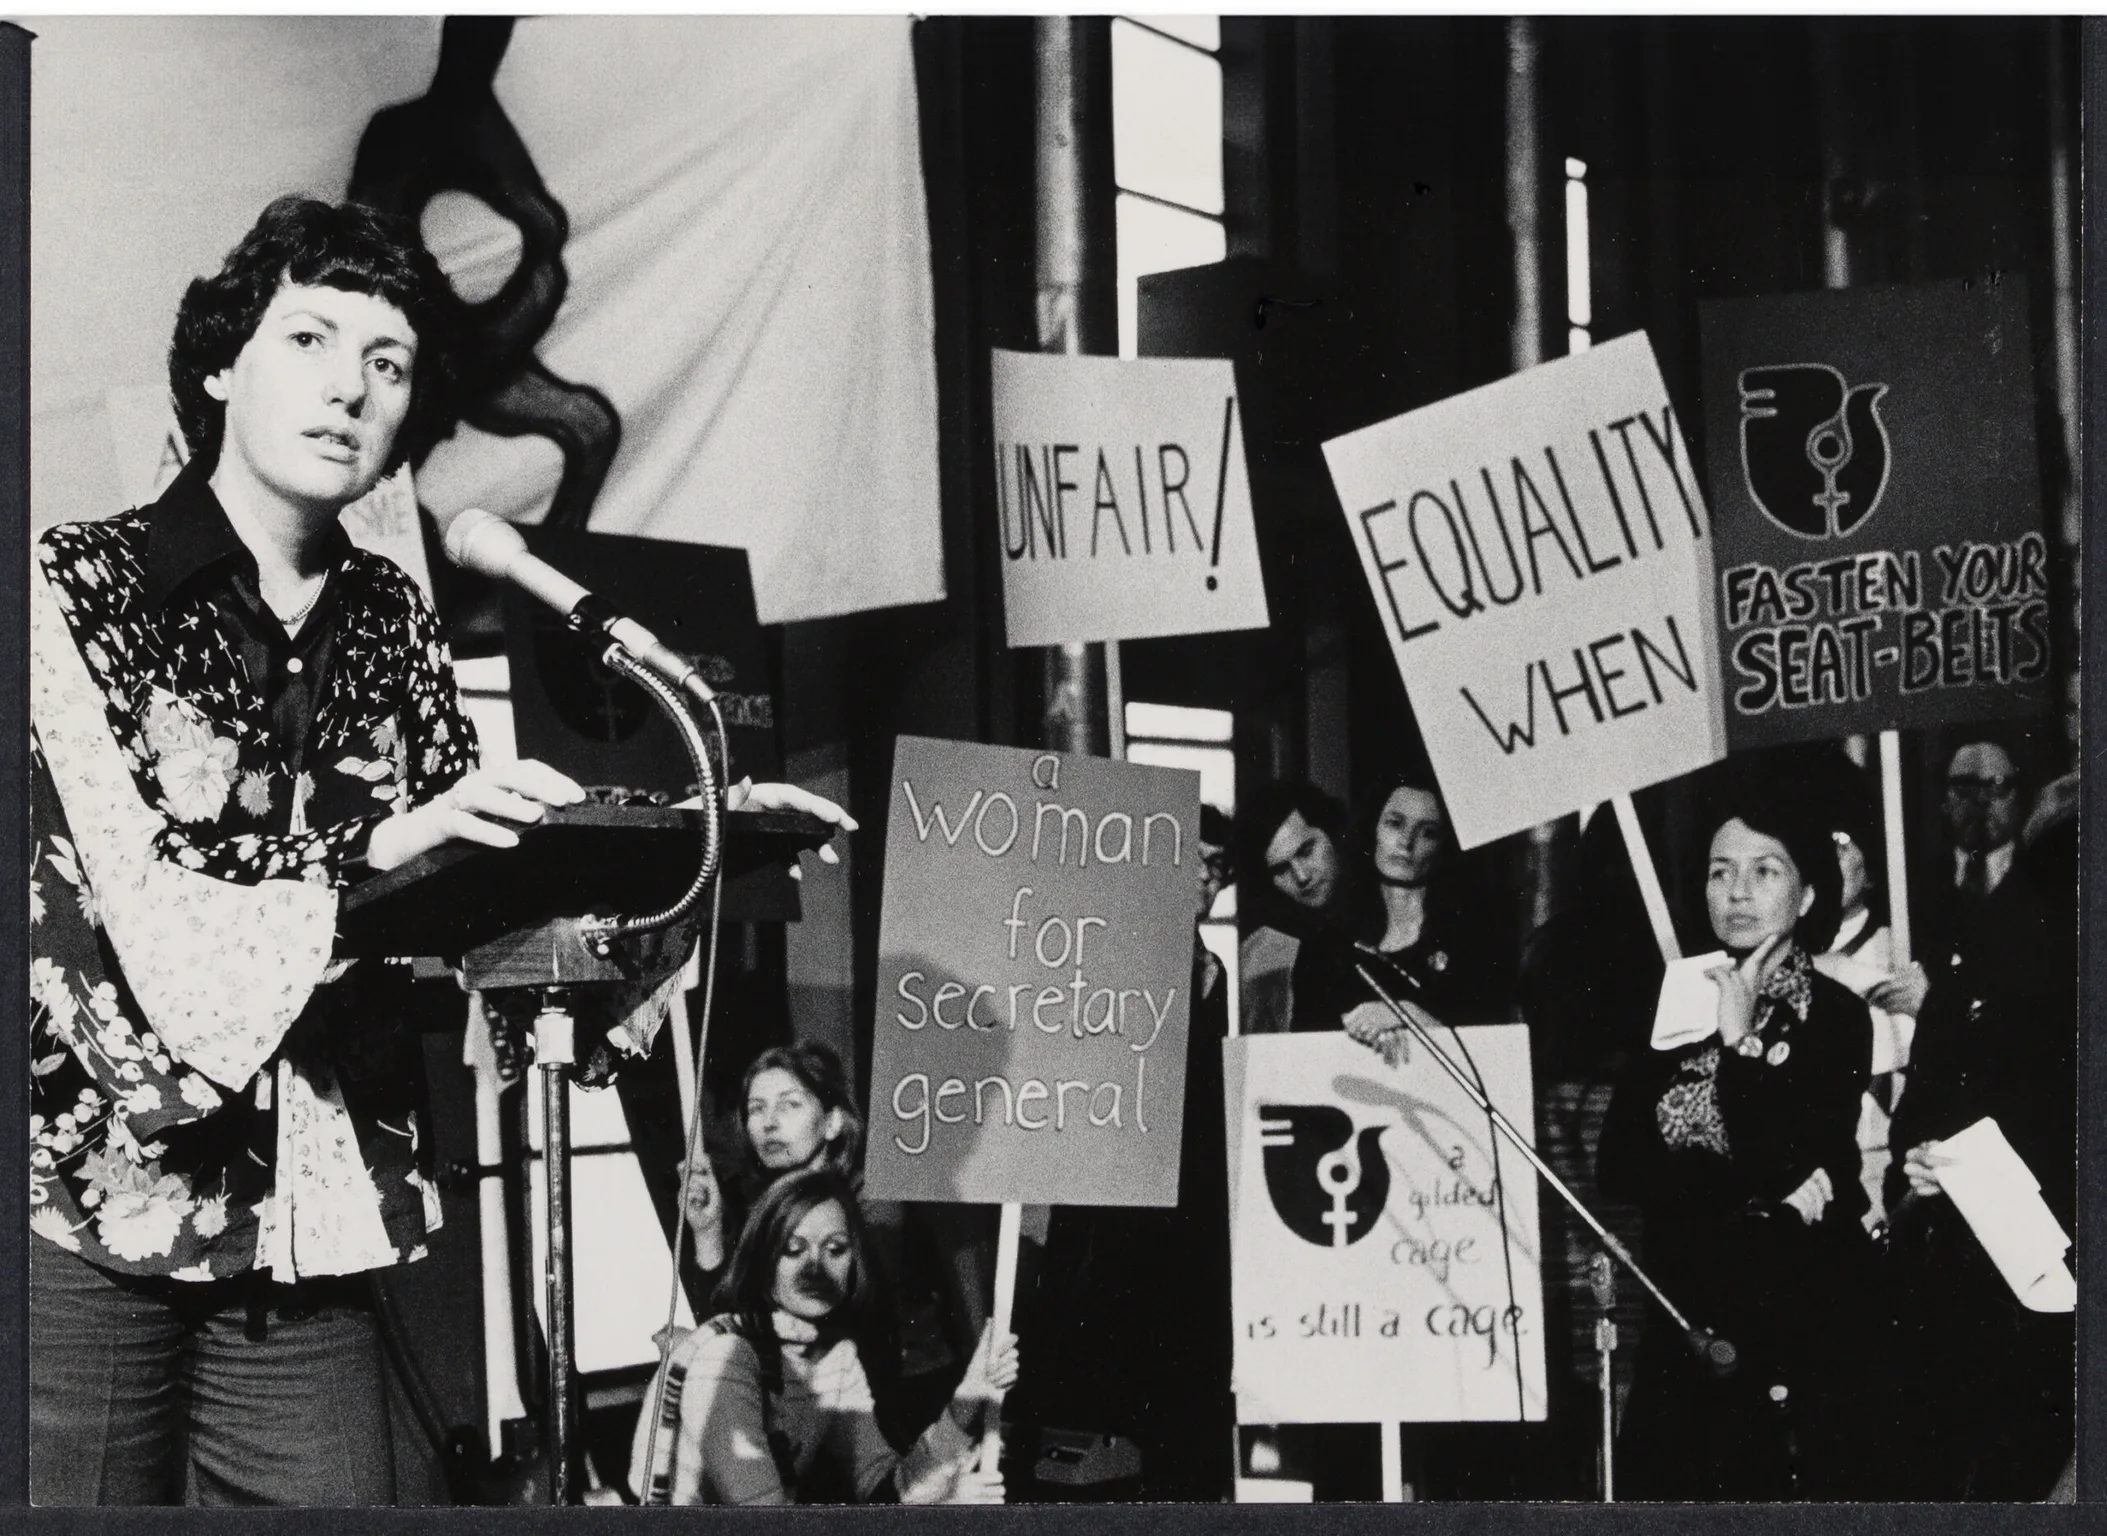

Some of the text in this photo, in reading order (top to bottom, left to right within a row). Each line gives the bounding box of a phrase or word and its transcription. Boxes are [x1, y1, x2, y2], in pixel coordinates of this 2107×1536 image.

[999, 396, 1233, 592] UNFAIR!
[1359, 404, 1702, 642] EQUALITY
[1723, 532, 2047, 630] FASTEN YOUR
[1460, 615, 1698, 755] WHEN
[1732, 601, 2050, 715] SEAT-BELTS
[1032, 754, 1061, 791] a
[1003, 887, 1107, 969] for
[897, 969, 1176, 1052] secretary
[892, 1057, 1149, 1155] general
[1448, 1146, 1466, 1171] a
[1390, 1236, 1481, 1284] cage
[1246, 1302, 1529, 1370] is still a cage
